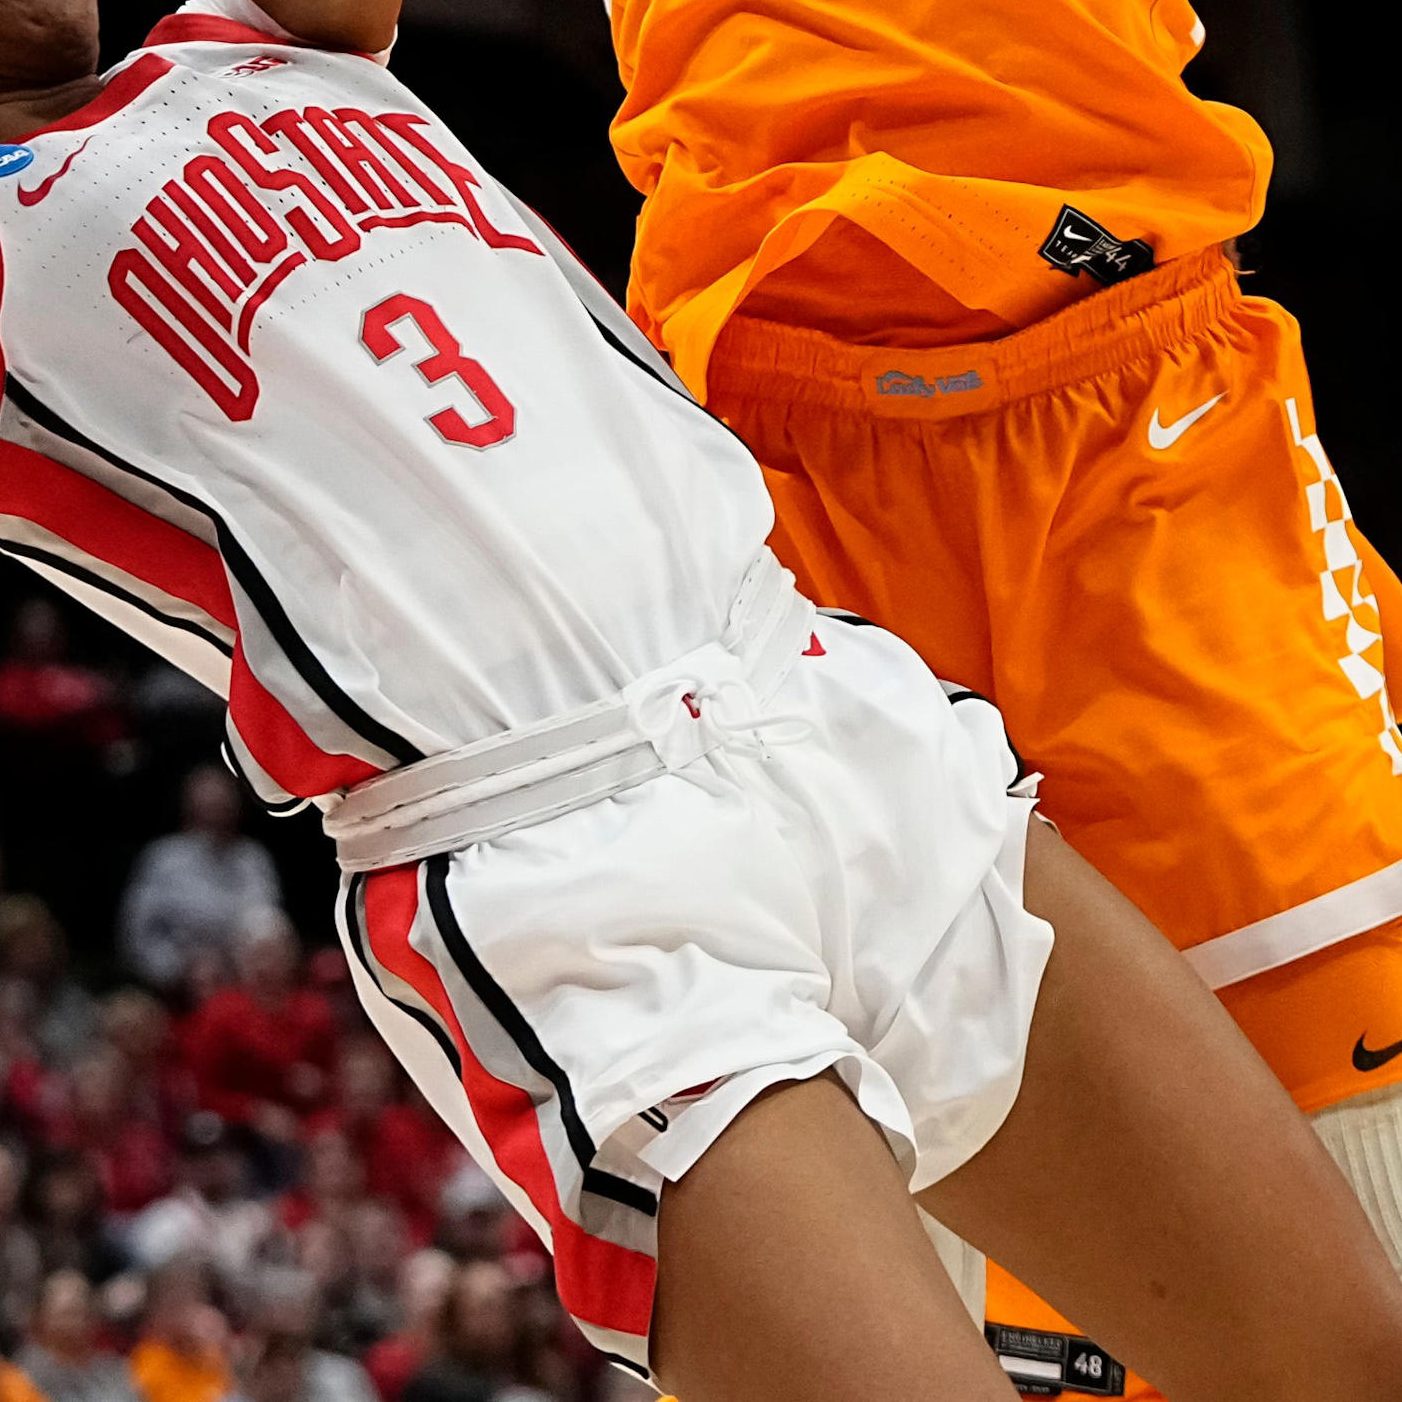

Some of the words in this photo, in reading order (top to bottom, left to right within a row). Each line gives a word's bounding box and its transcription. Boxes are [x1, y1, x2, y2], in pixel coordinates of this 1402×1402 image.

[1105, 247, 1131, 272] 44
[357, 292, 516, 452] 3
[1074, 1351, 1103, 1379] 48
